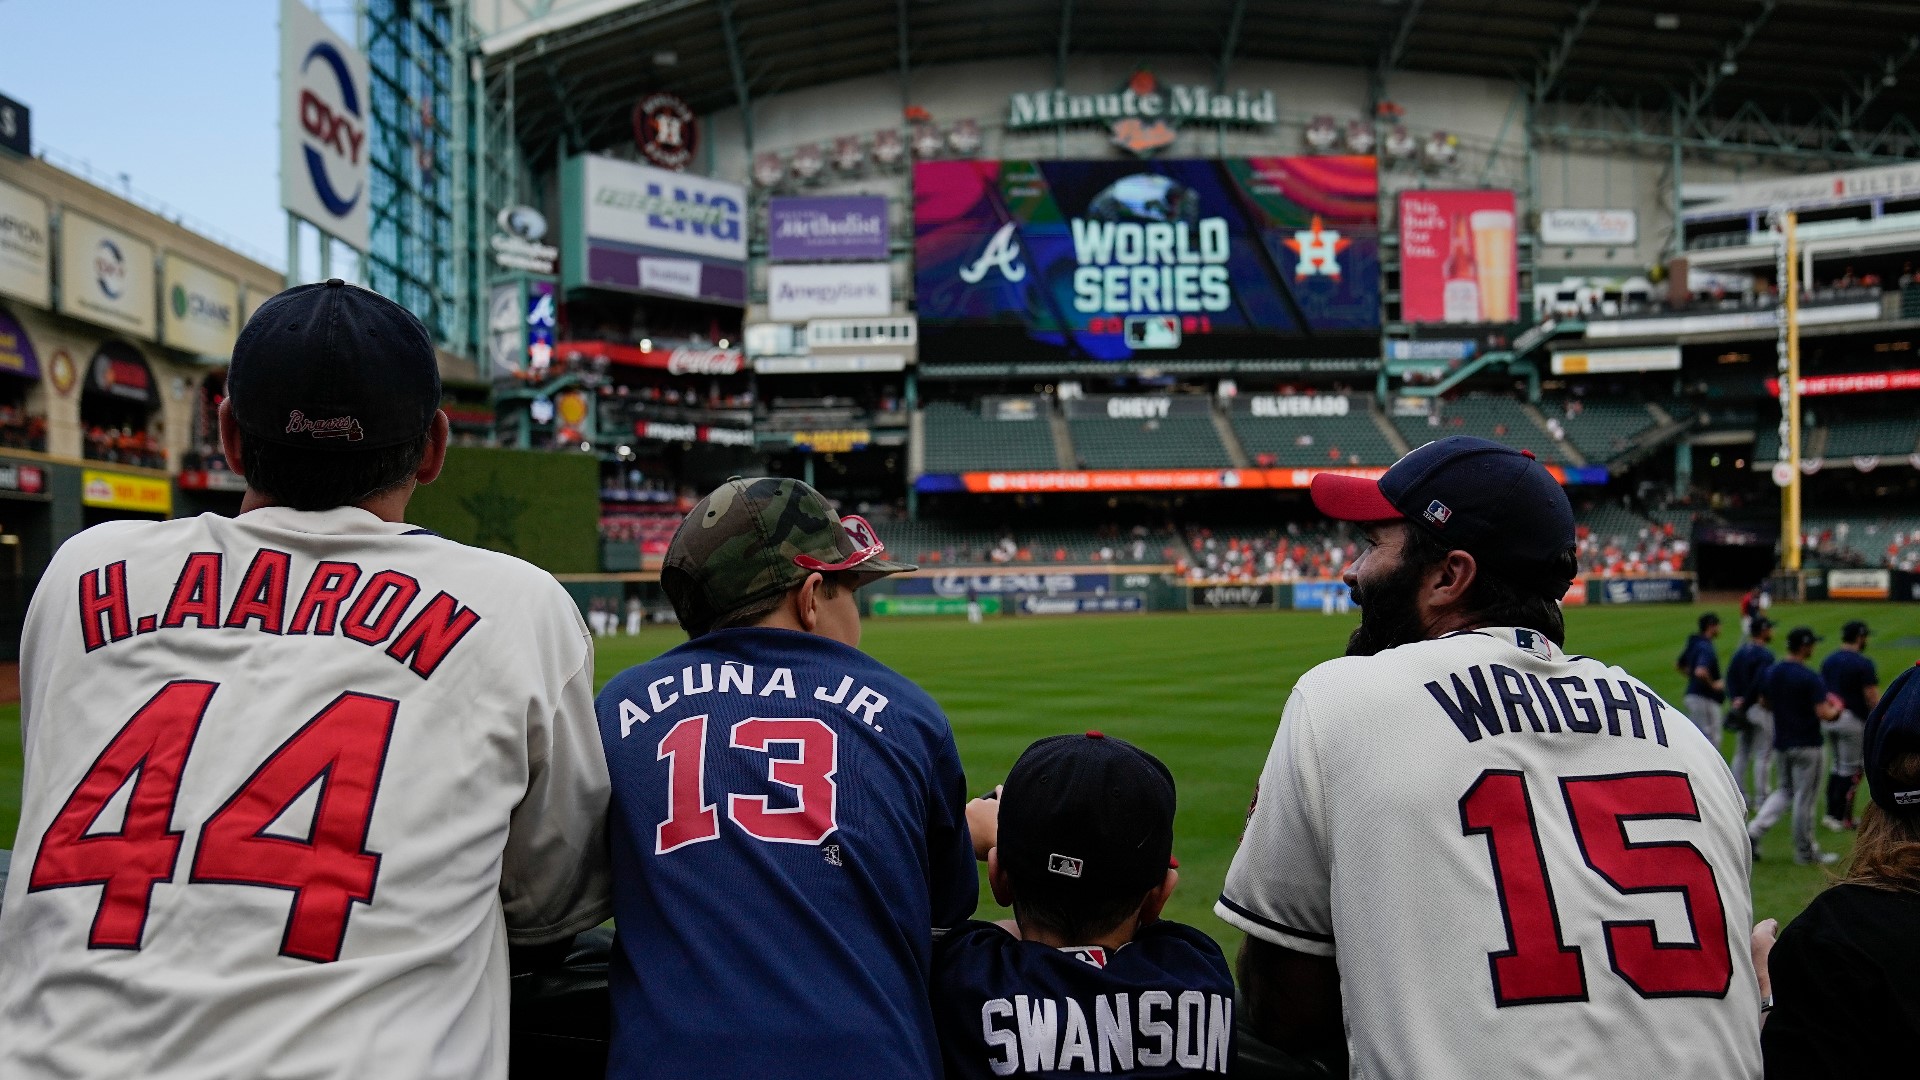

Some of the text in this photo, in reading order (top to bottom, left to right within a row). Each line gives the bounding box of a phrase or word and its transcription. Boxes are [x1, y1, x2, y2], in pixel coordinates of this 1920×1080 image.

[299, 87, 365, 164] OXY
[1010, 85, 1276, 126] Minute Maid
[647, 183, 740, 242] LNG
[1404, 200, 1437, 215] This
[1072, 217, 1230, 265] WORLD
[1074, 266, 1230, 312] SERIES
[286, 409, 352, 434] Braves
[1107, 396, 1171, 419] CHEVY
[1251, 395, 1349, 417] SILVERADO
[1204, 587, 1262, 608] xfinity
[619, 660, 890, 739] ACUÑA JR.
[1424, 663, 1668, 748] WRIGHT
[655, 714, 838, 855] 13
[27, 679, 400, 963] 44
[1458, 768, 1733, 1008] 15
[982, 990, 1232, 1076] SWANSON
